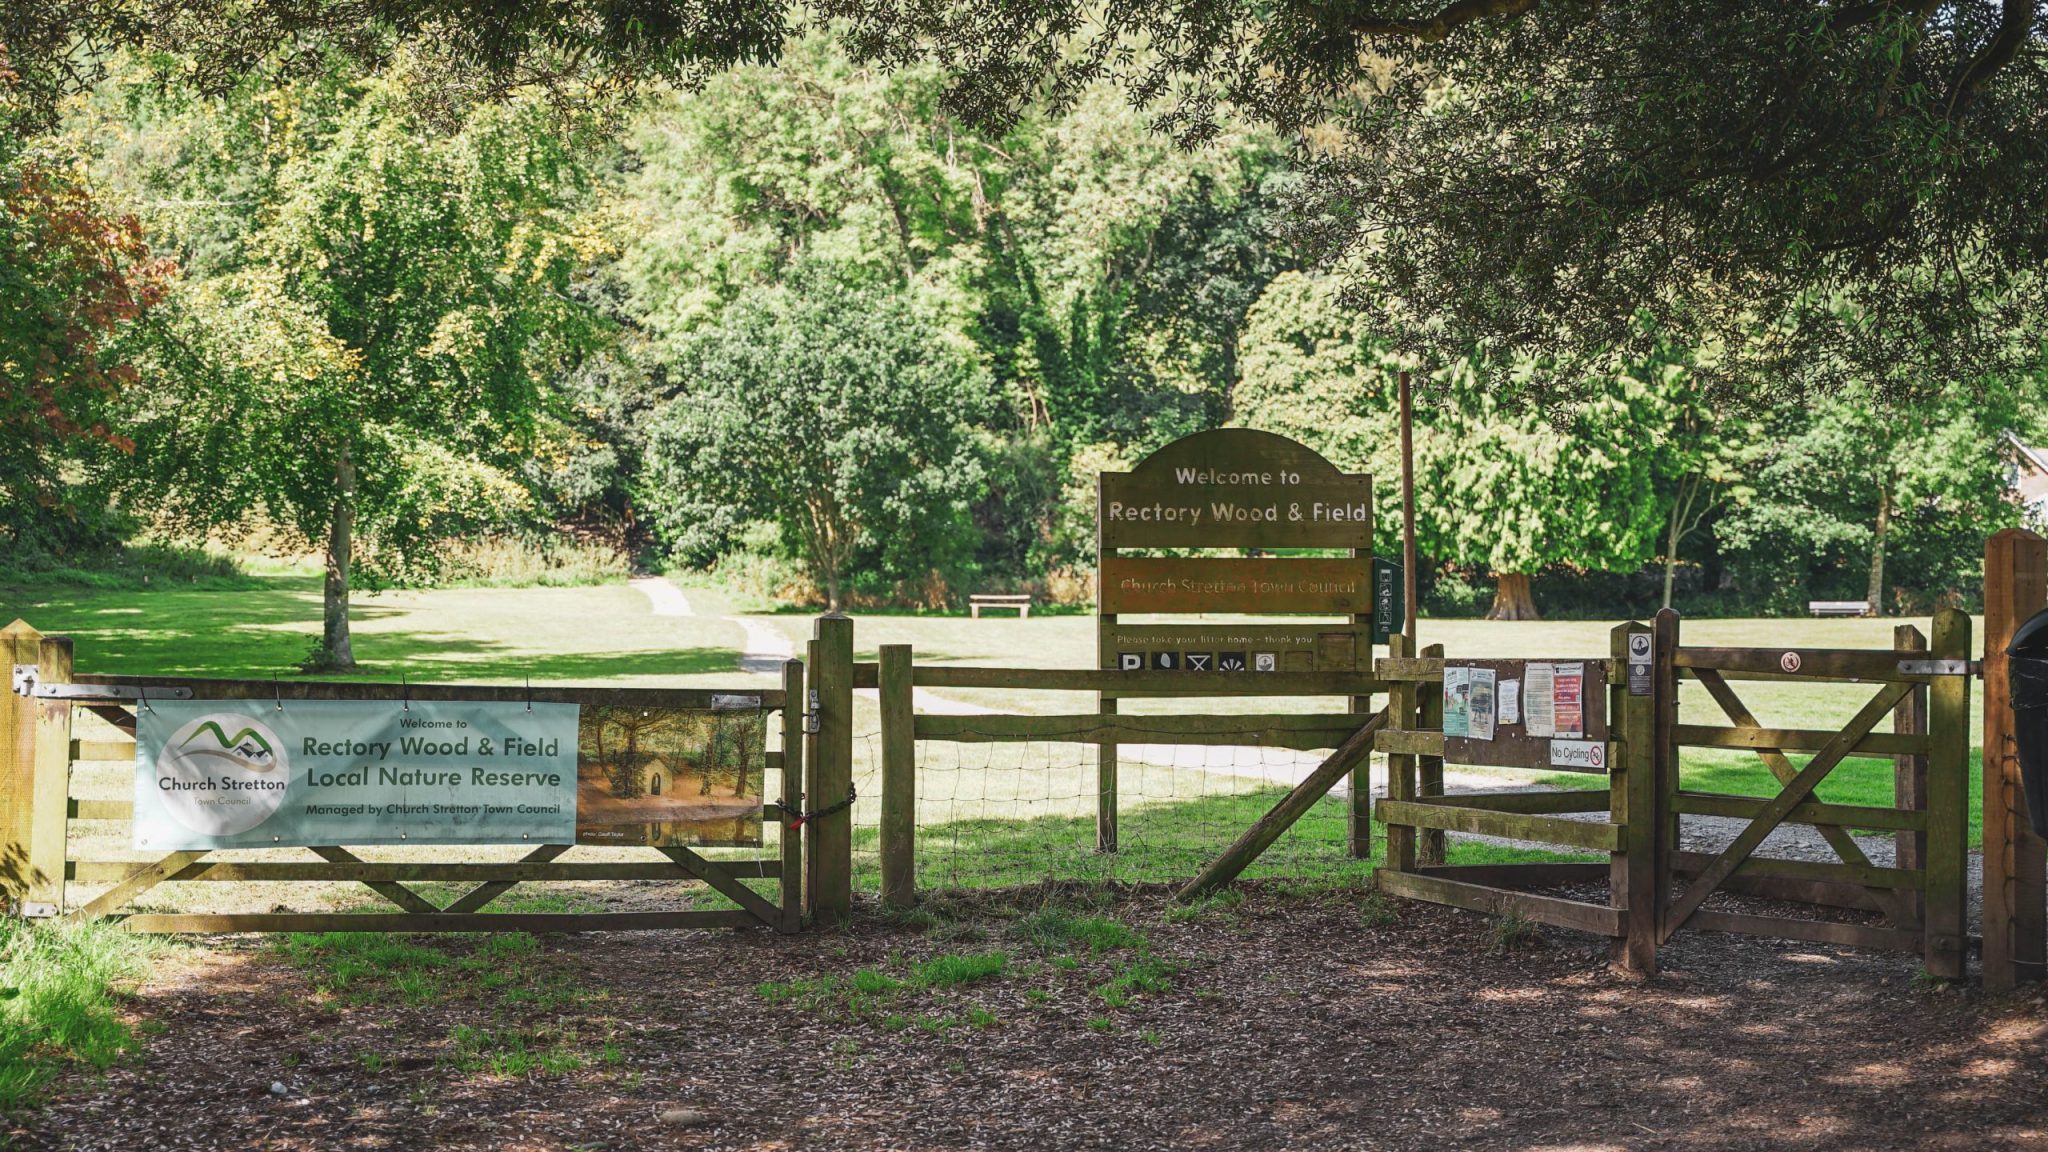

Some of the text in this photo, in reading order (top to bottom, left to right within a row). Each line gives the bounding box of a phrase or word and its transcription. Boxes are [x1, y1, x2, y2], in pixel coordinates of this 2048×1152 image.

[1175, 467, 1300, 485] Welcome to
[1109, 501, 1366, 527] Rectory Wood & Field
[1120, 578, 1355, 593] Church Stretton Town Council
[1117, 635, 1149, 644] Please
[1151, 635, 1172, 644] take
[1176, 636, 1196, 645] your
[1201, 635, 1224, 643] litter
[1227, 635, 1252, 643] home
[1265, 635, 1291, 643] thank
[1295, 636, 1312, 645] you
[400, 718, 467, 729] Welcome to
[303, 736, 559, 761] Rectory Wood & Field
[1552, 747, 1589, 762] No Cycling
[158, 776, 285, 791] Church Stretton
[307, 766, 560, 787] Local Nature Reserve
[193, 796, 251, 806] Town Council
[305, 803, 560, 816] Managed by Church Stretton Town Council
